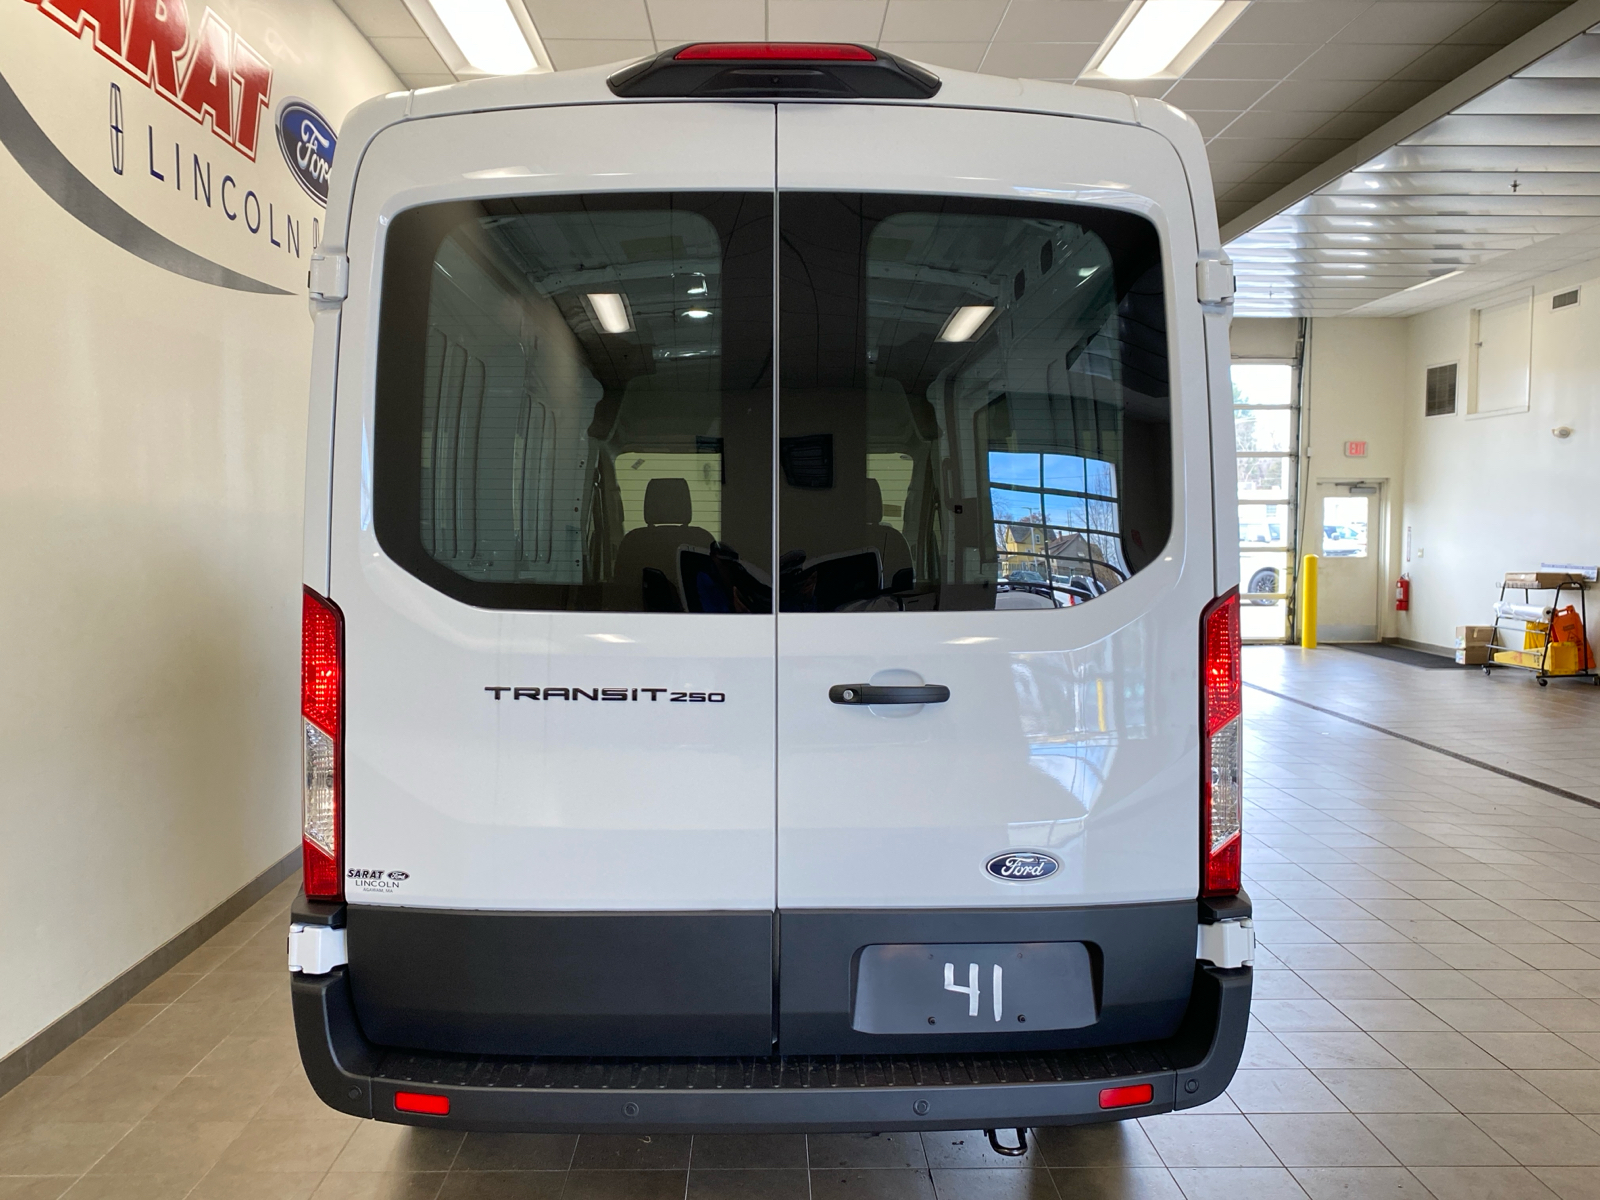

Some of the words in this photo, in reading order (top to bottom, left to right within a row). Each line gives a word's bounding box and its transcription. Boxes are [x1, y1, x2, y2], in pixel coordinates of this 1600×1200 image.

[23, 0, 273, 163] RAT
[296, 119, 332, 184] For
[147, 124, 300, 259] LINCOLN
[1349, 441, 1366, 456] EXIT
[484, 686, 668, 702] TRANSIT
[669, 692, 726, 703] 250
[347, 869, 385, 880] SARAT
[1001, 857, 1044, 876] Ford
[355, 880, 400, 888] LINCOLN
[944, 962, 1003, 1022] 41
